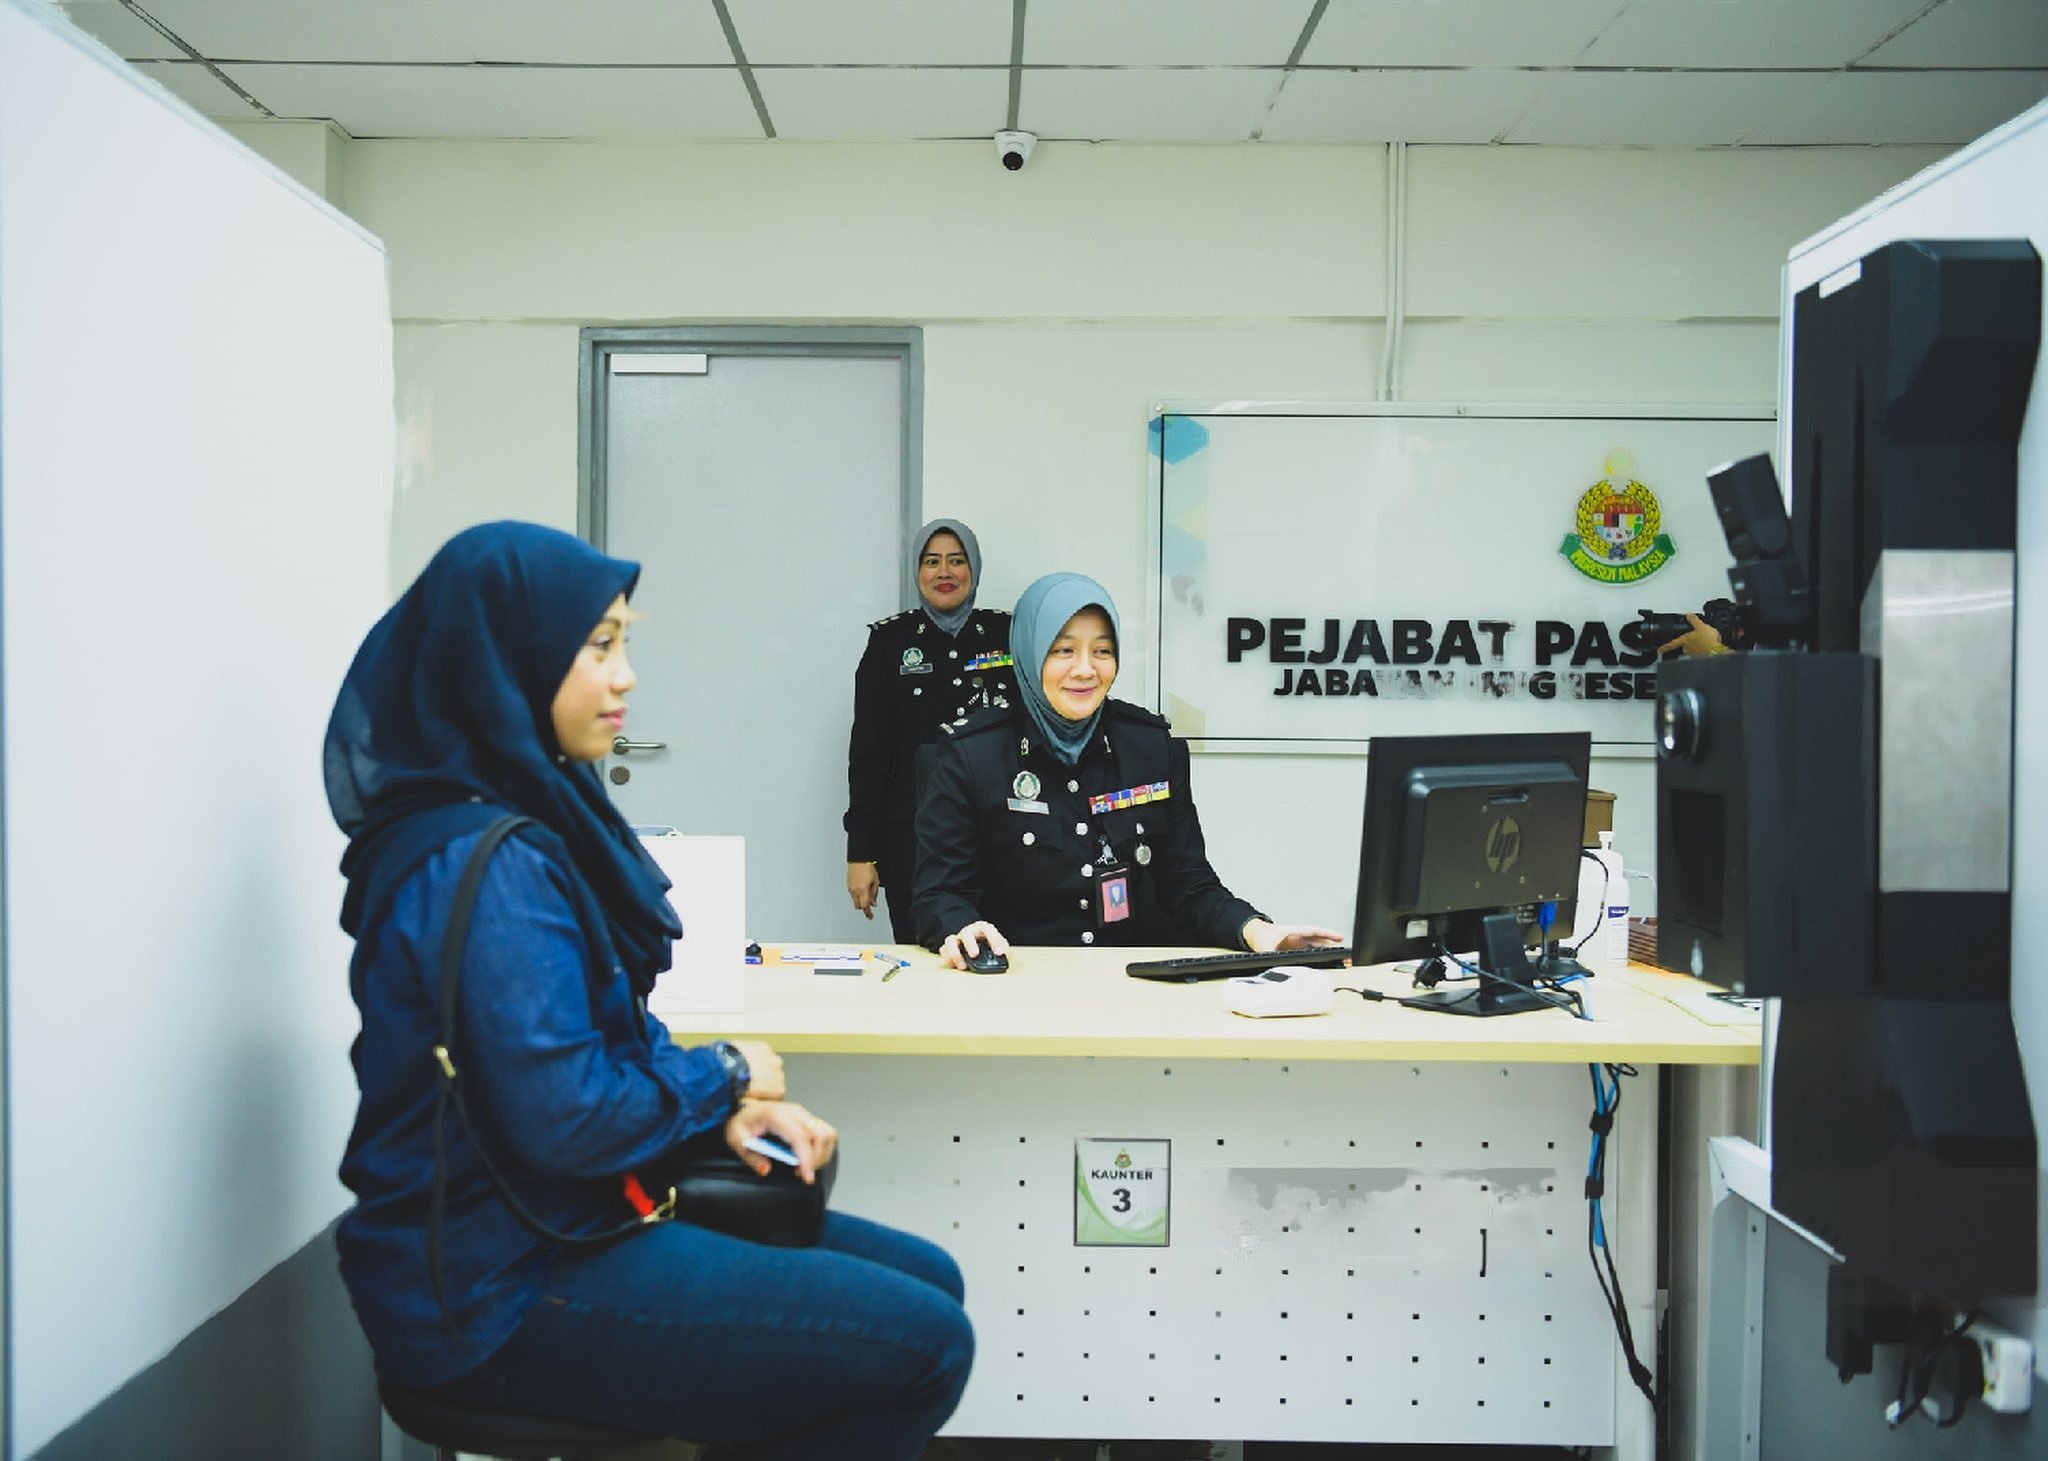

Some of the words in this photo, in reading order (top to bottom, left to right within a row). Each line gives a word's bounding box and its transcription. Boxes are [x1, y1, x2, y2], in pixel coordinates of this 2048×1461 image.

[1618, 549, 1665, 581] MALAYSIA
[1227, 617, 1516, 666] PEJABAT
[1273, 669, 1457, 698] JABA
[1091, 1169, 1153, 1180] KAUNTER
[1112, 1188, 1131, 1213] 3
